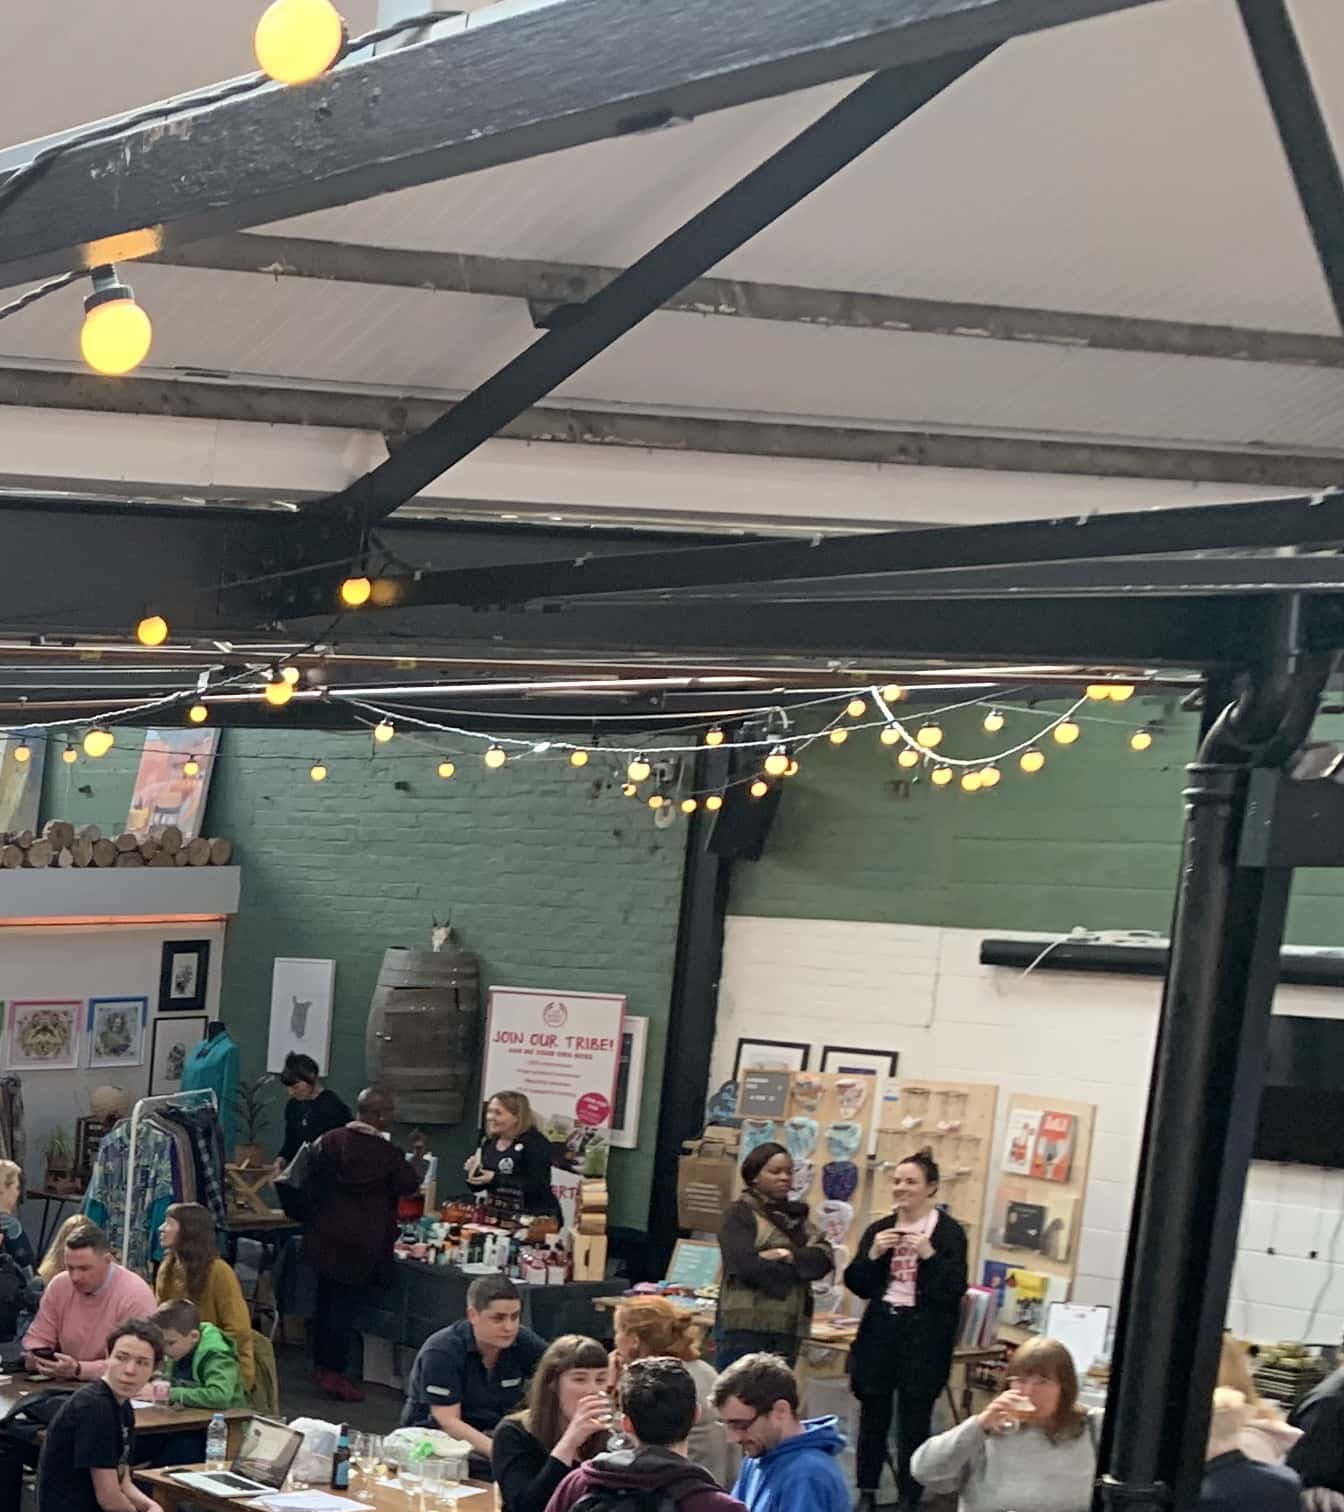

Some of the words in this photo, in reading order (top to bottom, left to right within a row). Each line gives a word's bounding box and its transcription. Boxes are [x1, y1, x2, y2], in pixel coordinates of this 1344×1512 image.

[493, 1031, 524, 1044] JOIN
[529, 1033, 558, 1048] OUR
[565, 1036, 614, 1051] TRIBE!
